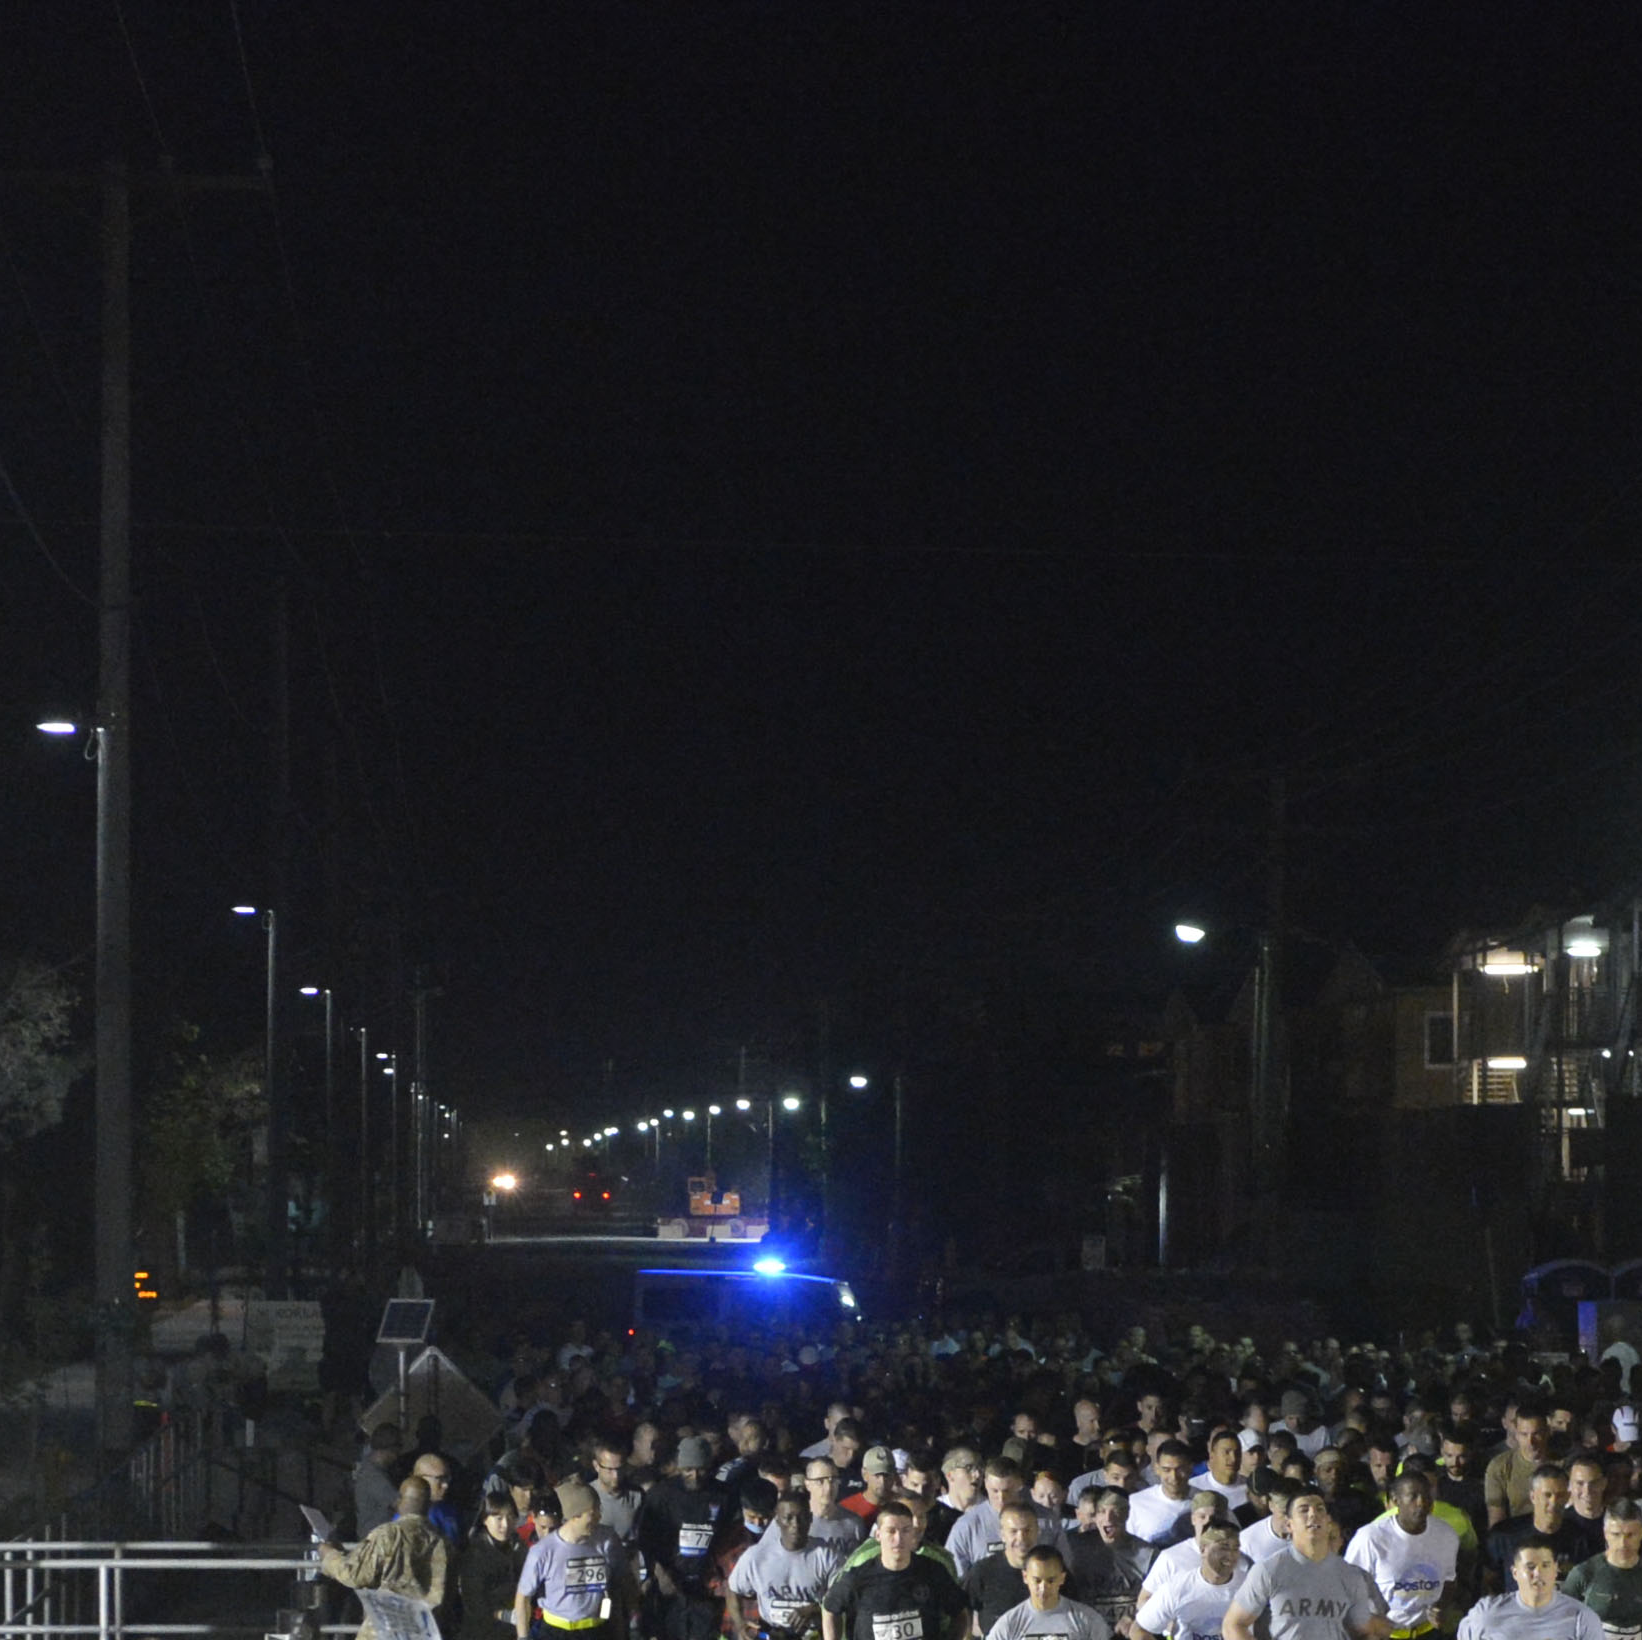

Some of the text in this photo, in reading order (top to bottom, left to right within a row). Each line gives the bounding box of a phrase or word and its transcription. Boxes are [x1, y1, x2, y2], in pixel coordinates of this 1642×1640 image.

[577, 1568, 605, 1584] 296
[1279, 1598, 1347, 1618] ARMY
[893, 1622, 914, 1640] 30
